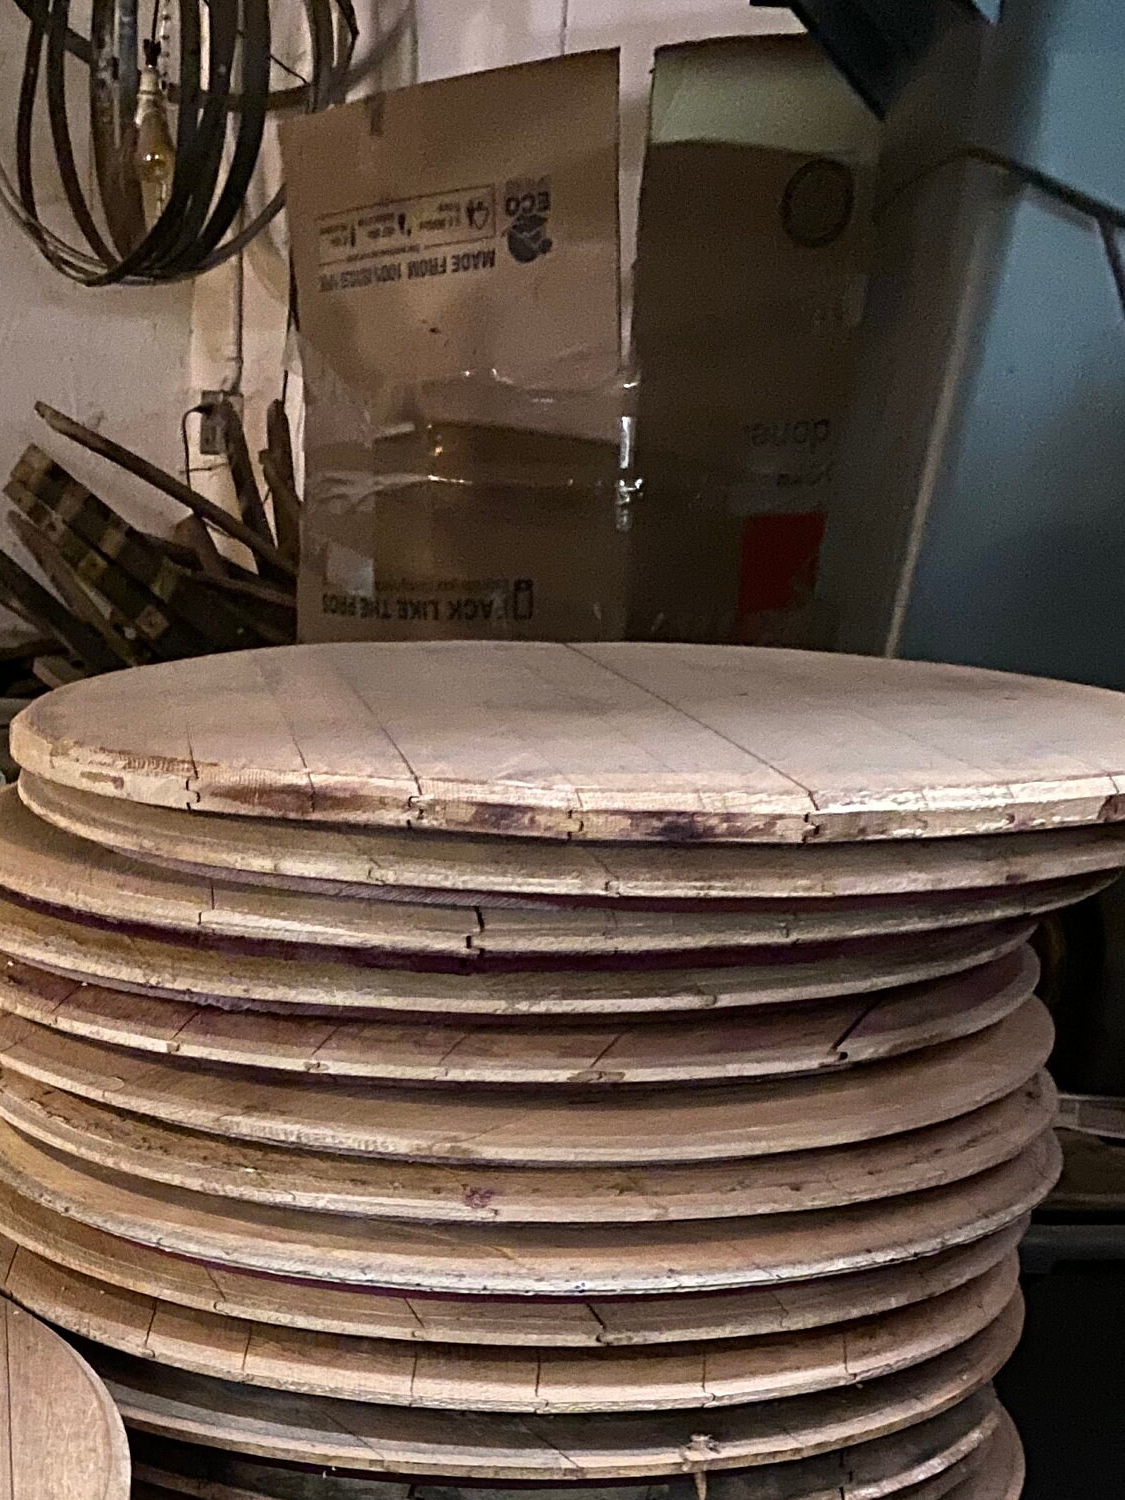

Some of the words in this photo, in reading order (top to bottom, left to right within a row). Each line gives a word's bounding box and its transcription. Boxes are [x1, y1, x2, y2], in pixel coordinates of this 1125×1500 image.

[505, 192, 551, 218] ECO
[407, 257, 447, 281] FROM
[452, 249, 496, 275] MADE
